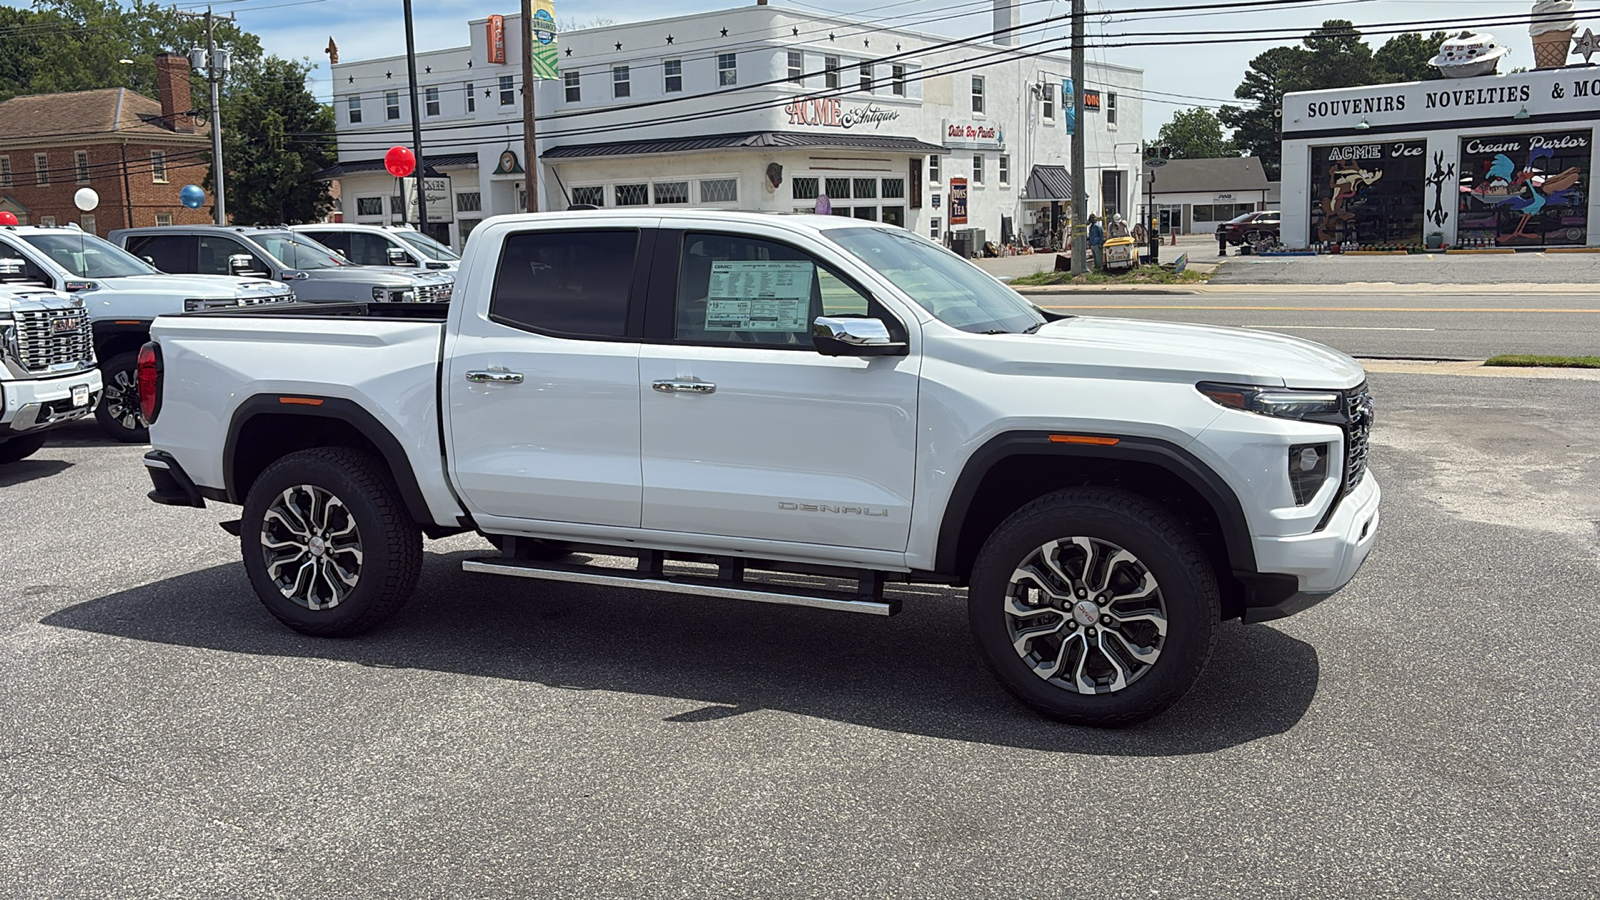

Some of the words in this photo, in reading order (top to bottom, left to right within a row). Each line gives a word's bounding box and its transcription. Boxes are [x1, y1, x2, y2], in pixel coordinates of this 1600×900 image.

[1307, 94, 1406, 118] SOUVENIRS
[1425, 84, 1531, 109] NOVELTIES
[1551, 82, 1565, 100] &
[785, 95, 842, 127] ACME
[842, 102, 899, 129] Antiques
[948, 124, 964, 138] Dutch
[966, 125, 977, 141] Boy
[977, 126, 995, 139] Paints
[1328, 144, 1382, 161] ACME
[1391, 143, 1424, 158] Ice
[1466, 139, 1521, 154] Cream
[1528, 135, 1589, 151] Parlor
[953, 203, 966, 216] TEA
[778, 501, 889, 517] DENALI
[1078, 603, 1095, 623] GMC
